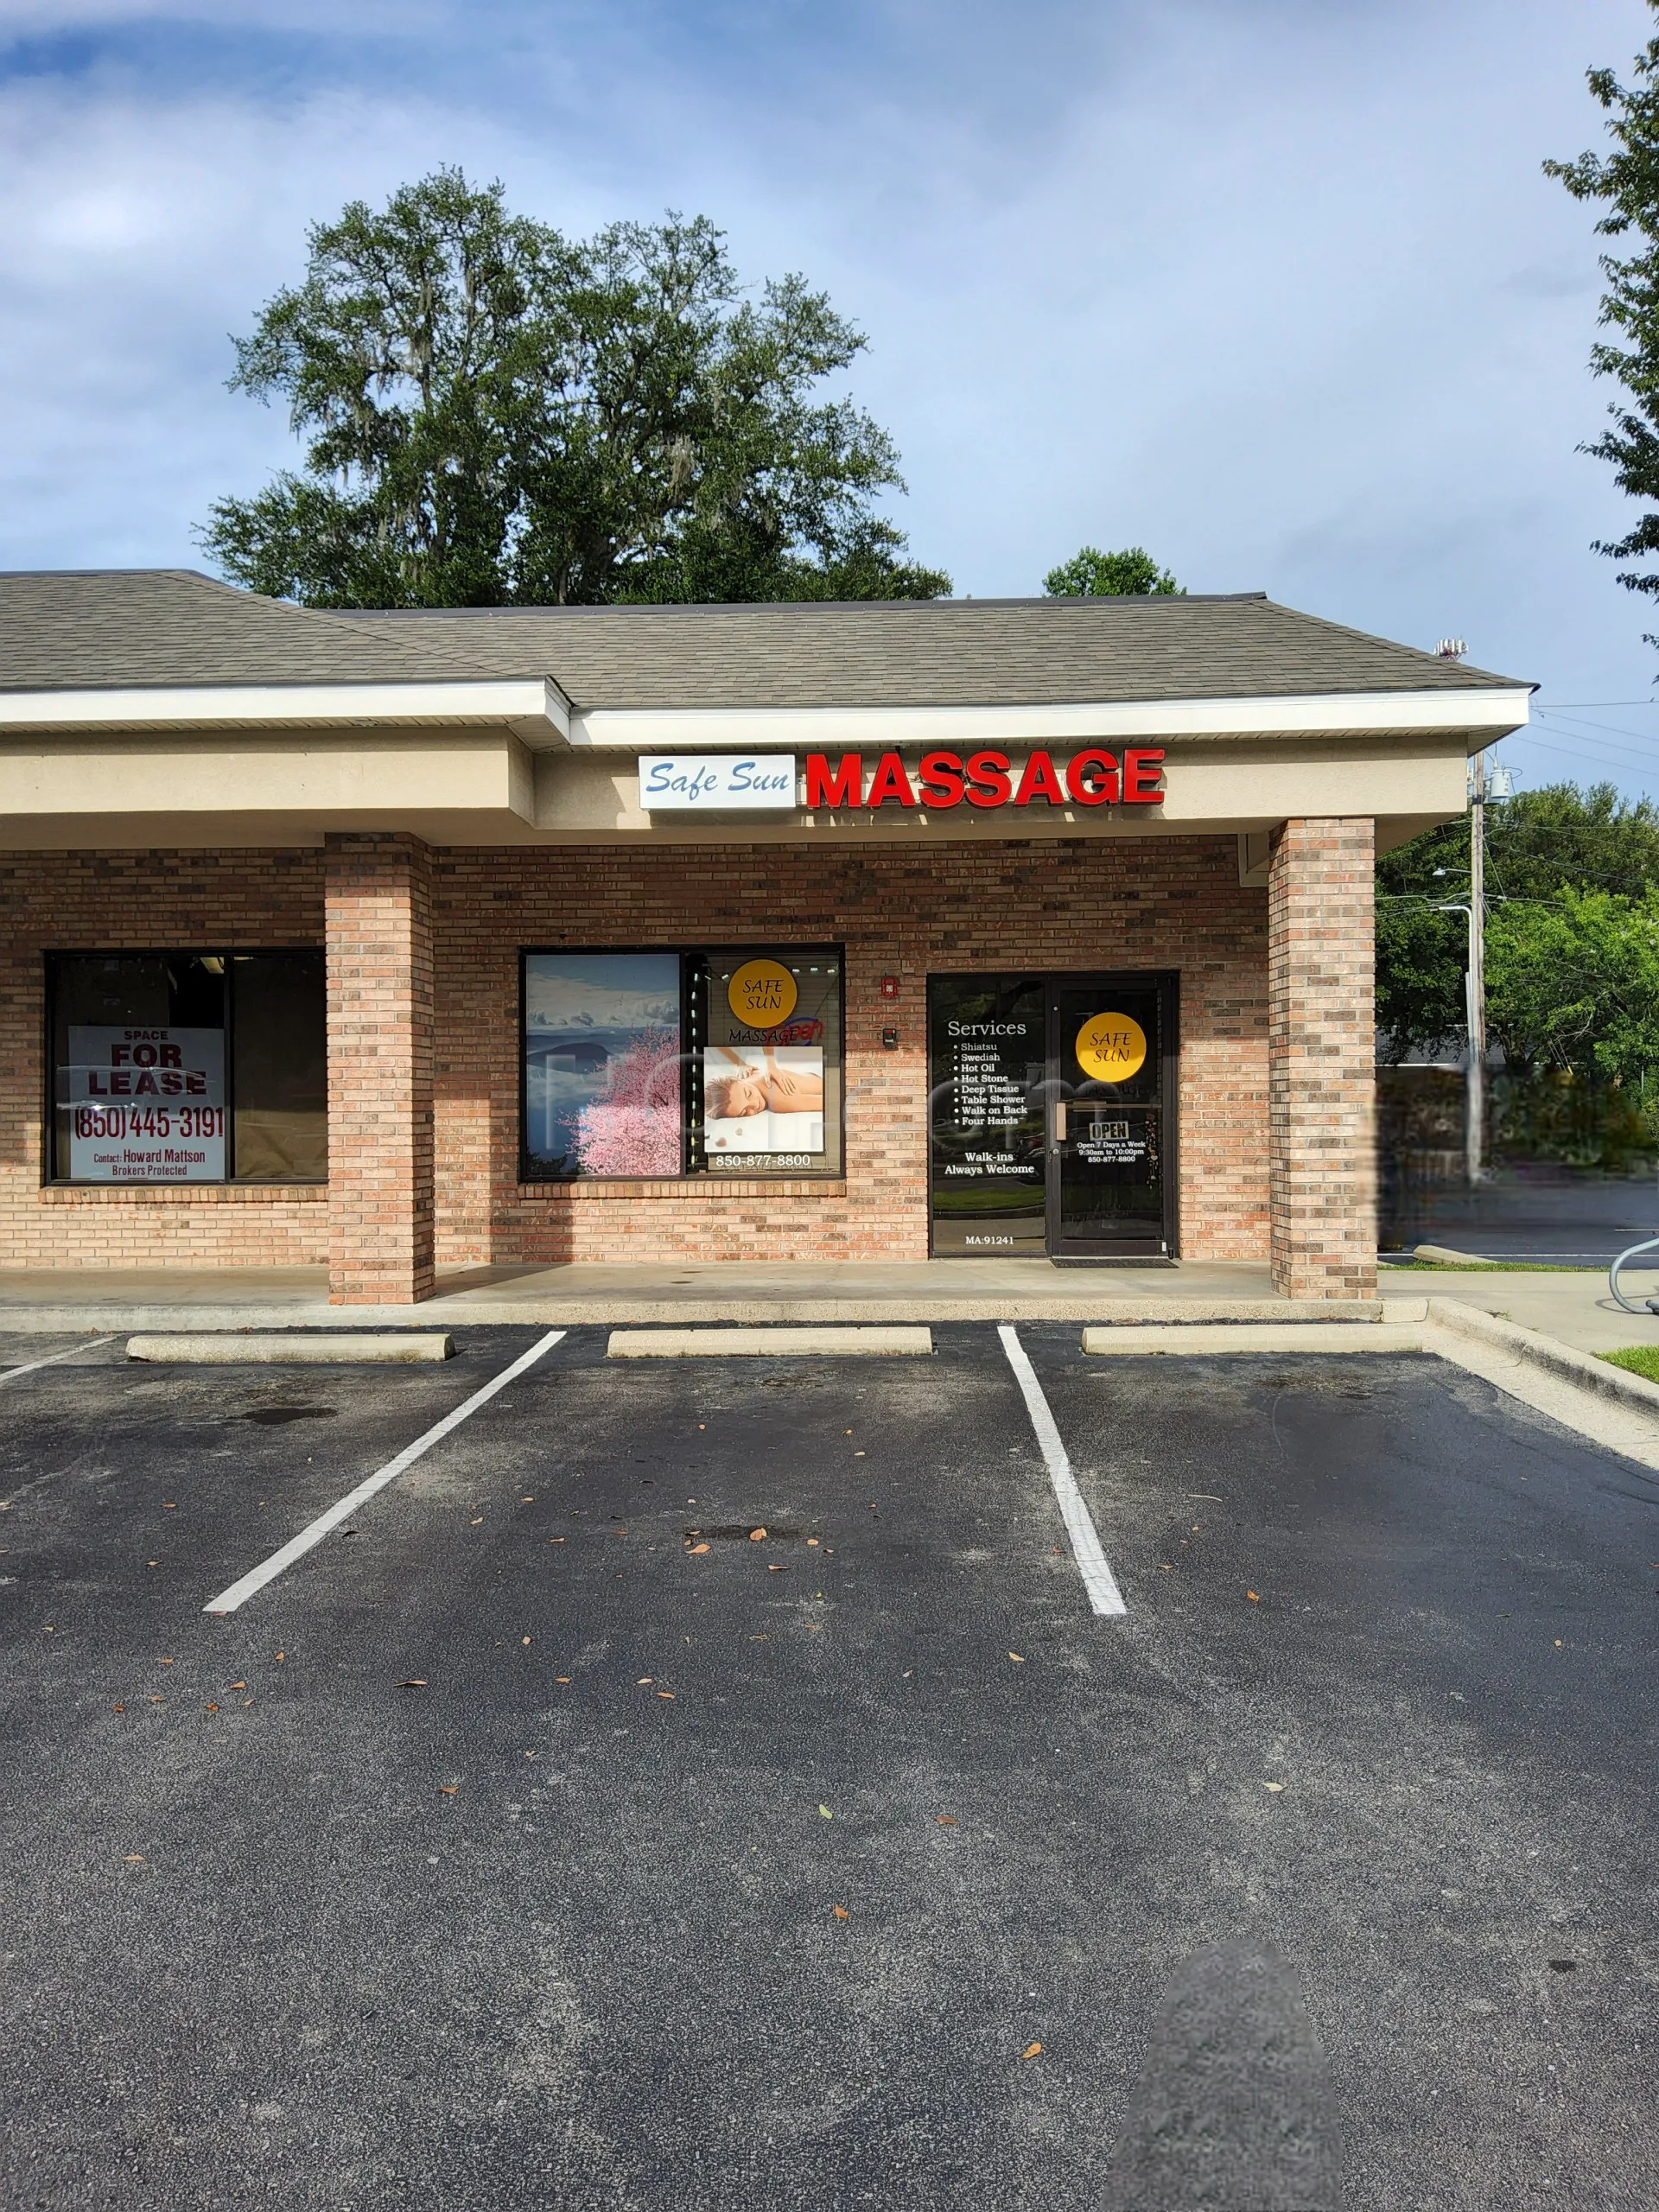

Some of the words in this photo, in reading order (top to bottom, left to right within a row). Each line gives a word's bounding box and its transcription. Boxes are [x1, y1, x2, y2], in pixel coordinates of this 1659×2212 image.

[645, 763, 719, 801] Safe
[728, 762, 790, 792] Sun
[805, 748, 1166, 810] MASSAGE
[742, 979, 784, 994] SAFE
[746, 995, 781, 1010] SUN
[124, 1030, 168, 1040] SPACE
[948, 1020, 1027, 1036] Services
[728, 1028, 798, 1043] MASSAGE
[1090, 1032, 1133, 1047] SAFE
[111, 1044, 182, 1067] FOR
[961, 1053, 1001, 1062] Swedish
[1093, 1048, 1130, 1063] SUN
[89, 1071, 207, 1096] LEASE
[981, 1074, 1008, 1083] Stone
[961, 1085, 986, 1095] Deep
[988, 1084, 1020, 1093] Tissue
[961, 1096, 988, 1104] Table
[962, 1106, 986, 1115] Walk
[1003, 1105, 1028, 1114] Back
[130, 1106, 224, 1138] 445-3191
[987, 1116, 1019, 1125] Hands
[1092, 1122, 1127, 1139] OPEN
[93, 1153, 122, 1163] Contact:
[124, 1149, 162, 1163] Howard
[165, 1149, 206, 1163] Mattson
[715, 1154, 810, 1166] 850-877-8800
[965, 1152, 1014, 1162] Walk-ins
[112, 1165, 145, 1176] Brokers
[148, 1165, 188, 1176] Protected
[944, 1165, 983, 1176] Always
[986, 1164, 1034, 1174] Welcome
[965, 1236, 1014, 1245] MA:91241
